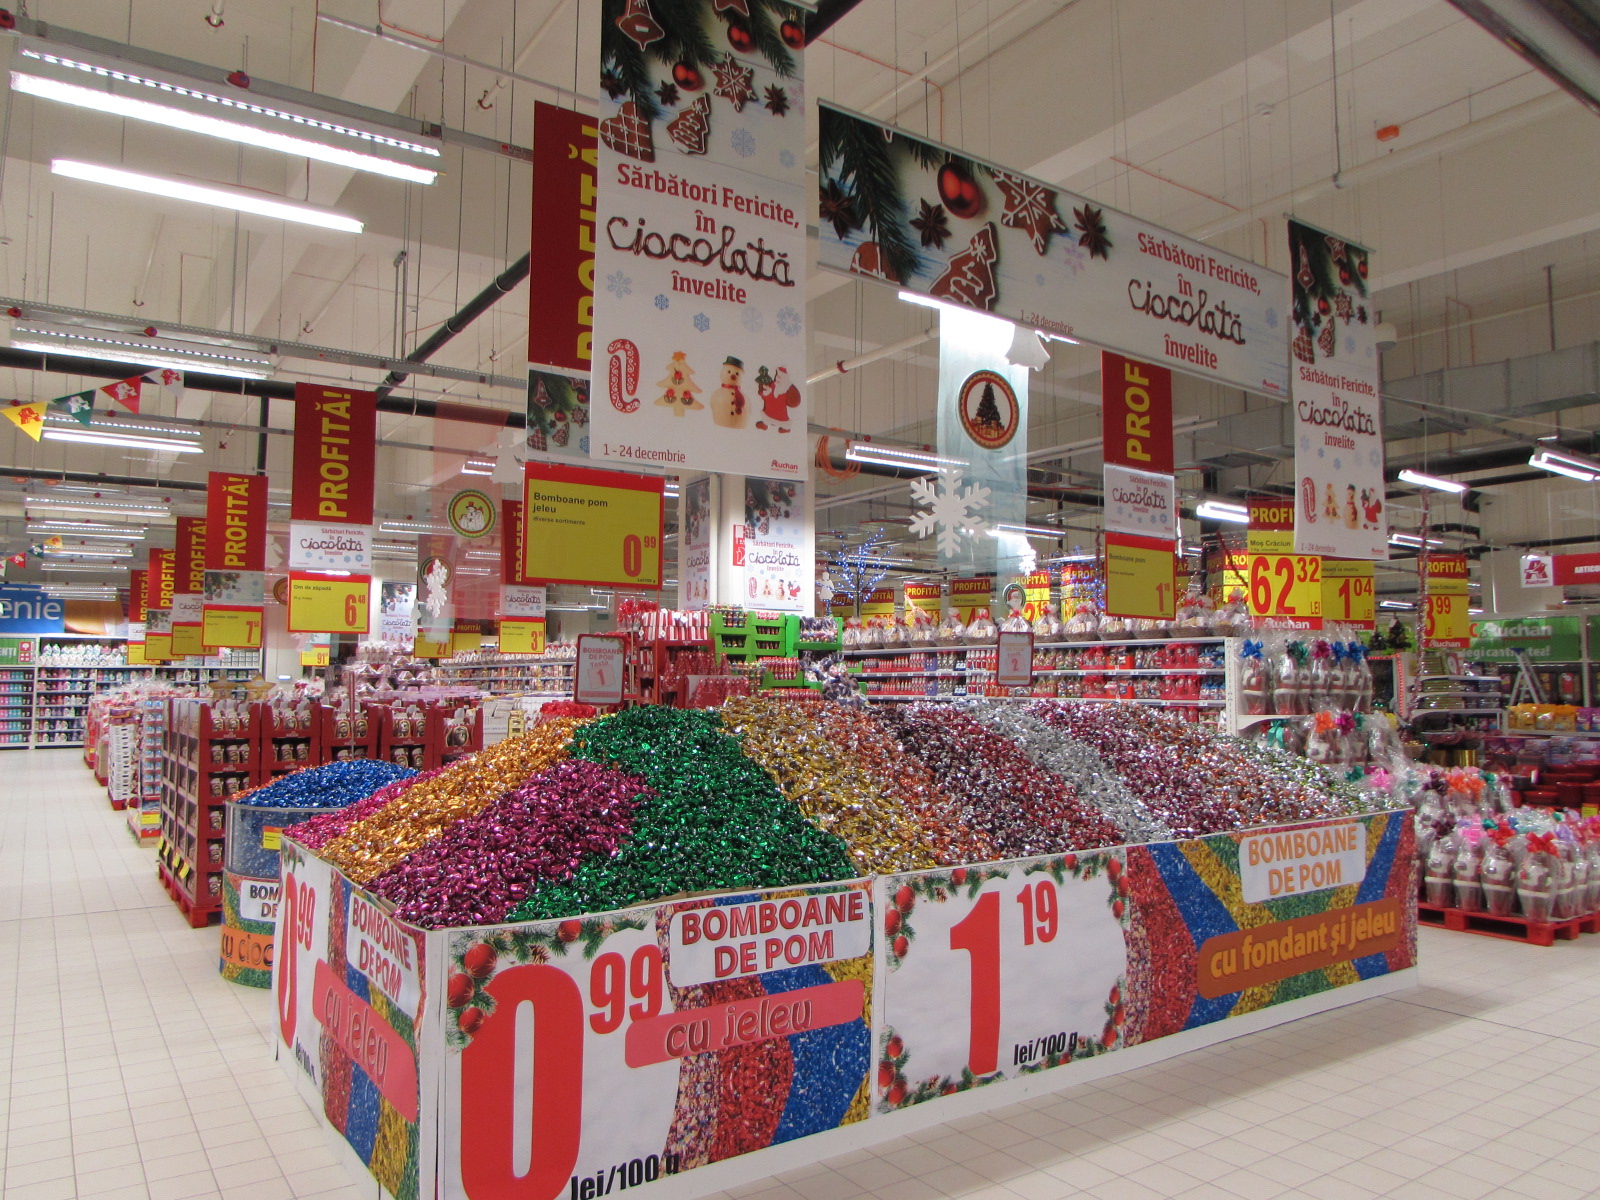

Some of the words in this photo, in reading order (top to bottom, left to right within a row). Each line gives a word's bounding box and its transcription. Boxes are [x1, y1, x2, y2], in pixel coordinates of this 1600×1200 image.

[617, 163, 717, 205] Sărbători
[722, 187, 800, 229] Fericite,
[695, 209, 716, 234] în
[606, 215, 795, 287] Ciocolată
[1138, 232, 1206, 274] Sărbători
[1207, 257, 1261, 296] Fericite,
[671, 270, 747, 304] învelite
[1177, 273, 1193, 297] în
[1041, 315, 1074, 334] decembrie
[1128, 278, 1246, 345] Ciocolată
[1164, 333, 1218, 369] învelite
[1300, 366, 1340, 389] Sărbători
[1341, 376, 1376, 397] Fericite,
[1124, 355, 1151, 462] PROF
[1298, 400, 1376, 436] Ciocolată
[315, 391, 352, 517] PROFITĂ!
[619, 444, 632, 458] 24
[634, 445, 686, 463] decembrie
[1324, 432, 1355, 450] învelite
[771, 459, 798, 470] Auchan
[533, 503, 556, 513] jeleu
[534, 492, 585, 505] Bomboane
[588, 498, 608, 508] pom
[1250, 507, 1294, 523] PROFI
[222, 477, 250, 567] PROFITĂ!
[301, 536, 363, 551] Ciocolată
[623, 534, 641, 577] 0
[644, 536, 656, 549] 99
[907, 588, 940, 596] PROFITĂ!
[954, 581, 989, 591] PROFITĂ!
[1251, 556, 1296, 614] 62
[1297, 557, 1320, 582] 32
[345, 594, 356, 626] 6
[1248, 825, 1358, 867] BOMBOANE
[1268, 866, 1295, 895] DE
[1299, 860, 1342, 888] POM
[353, 897, 411, 971] BOMBOANE
[682, 892, 864, 946] BOMBOANE
[714, 944, 757, 978] DE
[765, 930, 834, 969] POM
[1210, 949, 1237, 980] cu
[1242, 925, 1328, 975] fondant
[1331, 917, 1348, 955] și
[1350, 907, 1396, 953] jeleu
[360, 939, 374, 978] DE
[376, 956, 403, 1003] POM
[590, 944, 664, 1035] 99
[950, 891, 1000, 1076] 1
[1016, 880, 1059, 946] 19
[344, 994, 388, 1087] jeleu
[666, 1024, 712, 1058] cu
[723, 999, 813, 1047] jeleu
[1014, 1037, 1065, 1066] lei/100
[1067, 1032, 1079, 1053] g
[571, 1154, 659, 1200] lei/100
